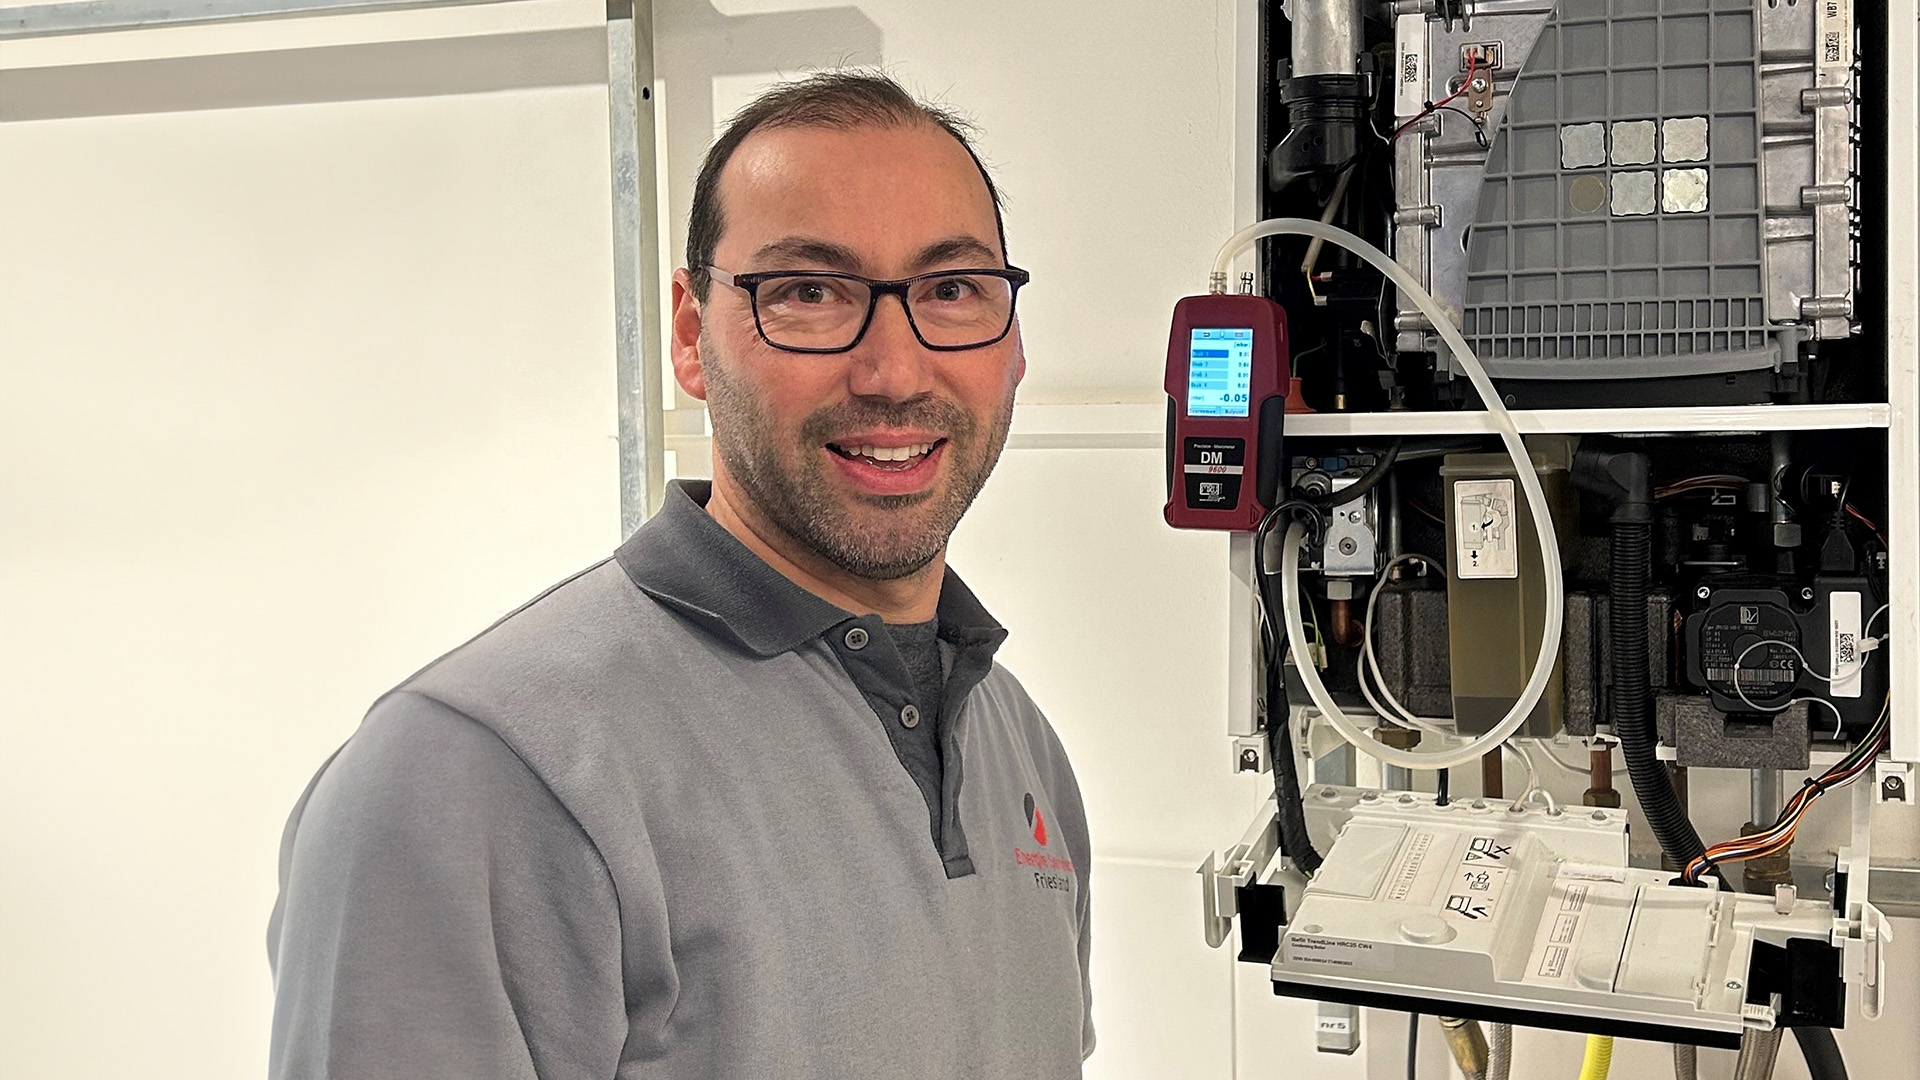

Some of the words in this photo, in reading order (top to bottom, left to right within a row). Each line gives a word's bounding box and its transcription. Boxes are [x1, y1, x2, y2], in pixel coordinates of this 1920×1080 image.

[1219, 393, 1248, 403] -0.05
[1200, 451, 1223, 464] DM
[1472, 560, 1480, 568] 2.
[1034, 872, 1070, 892] Friesand
